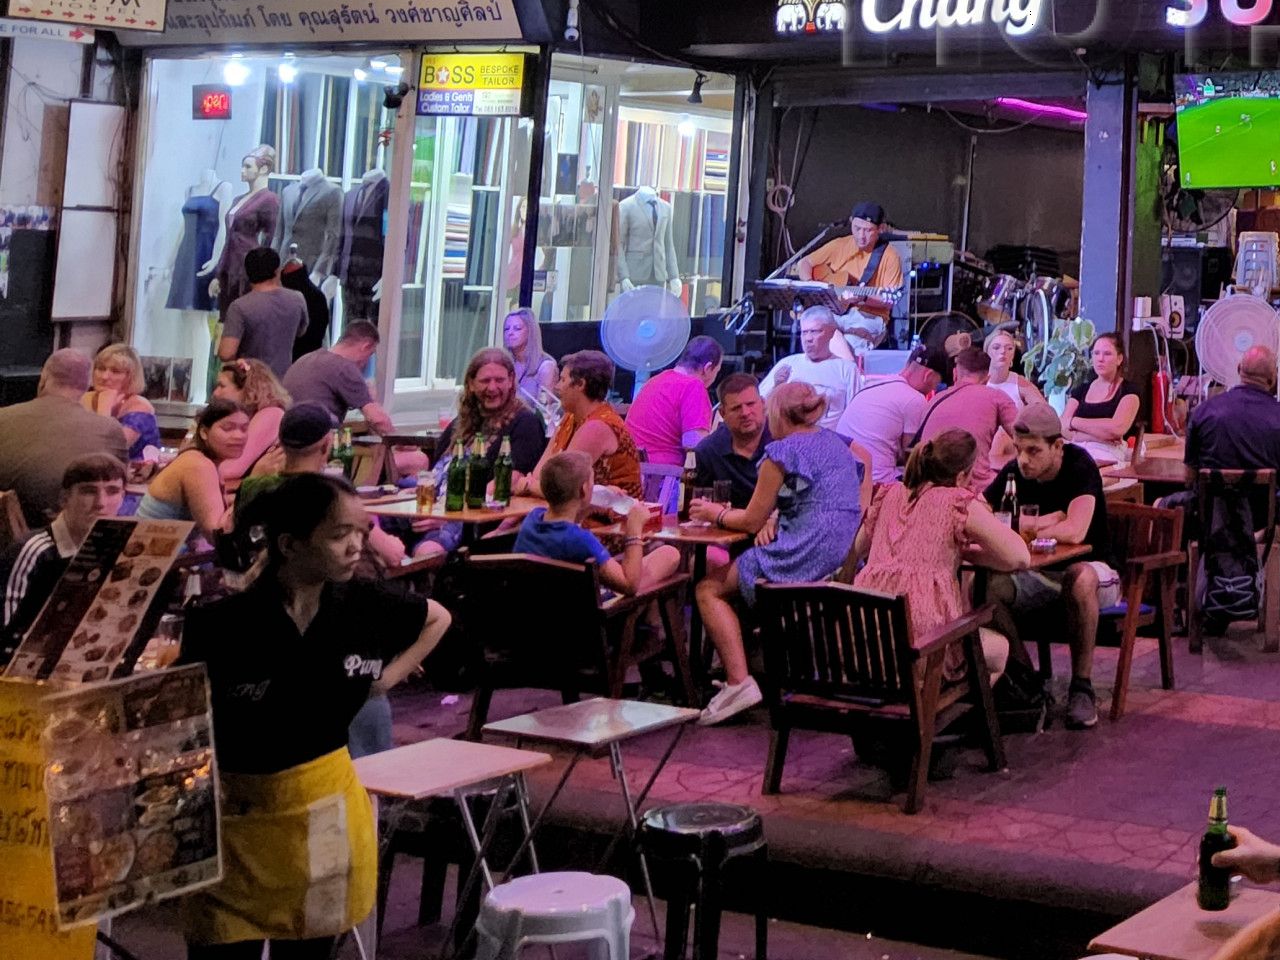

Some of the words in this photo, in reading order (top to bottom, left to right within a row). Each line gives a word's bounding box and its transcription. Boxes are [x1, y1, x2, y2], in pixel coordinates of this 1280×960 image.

[50, 0, 141, 16] HOSTEL
[12, 24, 37, 35] FOR
[41, 27, 65, 37] ALL
[424, 65, 475, 84] BOSS
[480, 64, 519, 75] BESPOKE
[483, 76, 514, 86] TAILOR
[420, 91, 442, 102] Ladies
[421, 102, 449, 114] Custom
[451, 102, 470, 113] Tailor
